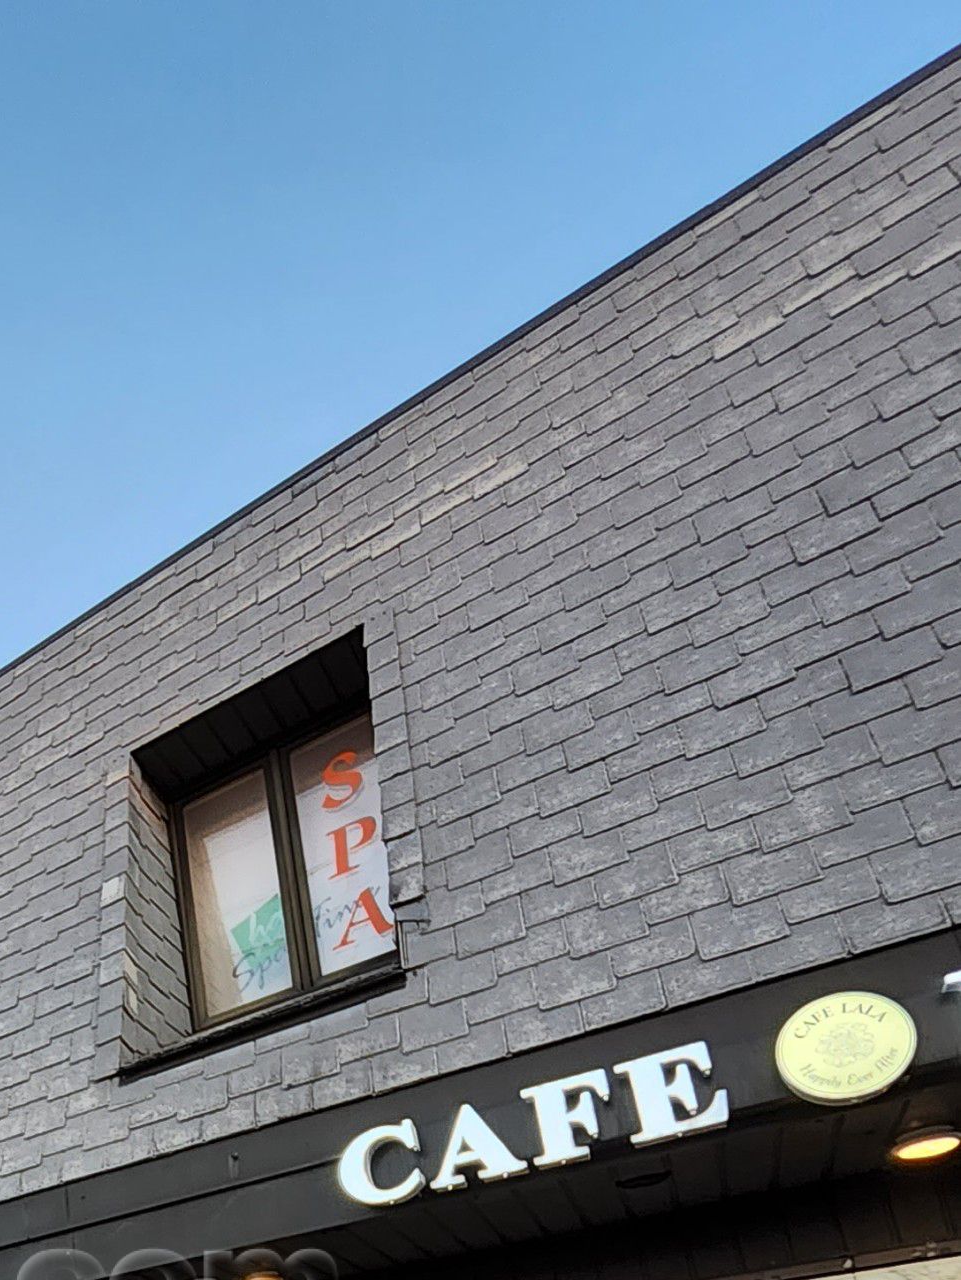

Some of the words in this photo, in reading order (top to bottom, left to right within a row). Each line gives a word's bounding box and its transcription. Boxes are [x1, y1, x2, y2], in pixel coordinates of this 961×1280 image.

[321, 751, 394, 950] SPA
[794, 1007, 835, 1039] CAFE
[842, 1003, 887, 1023] LALA
[337, 1040, 729, 1206] CAFE
